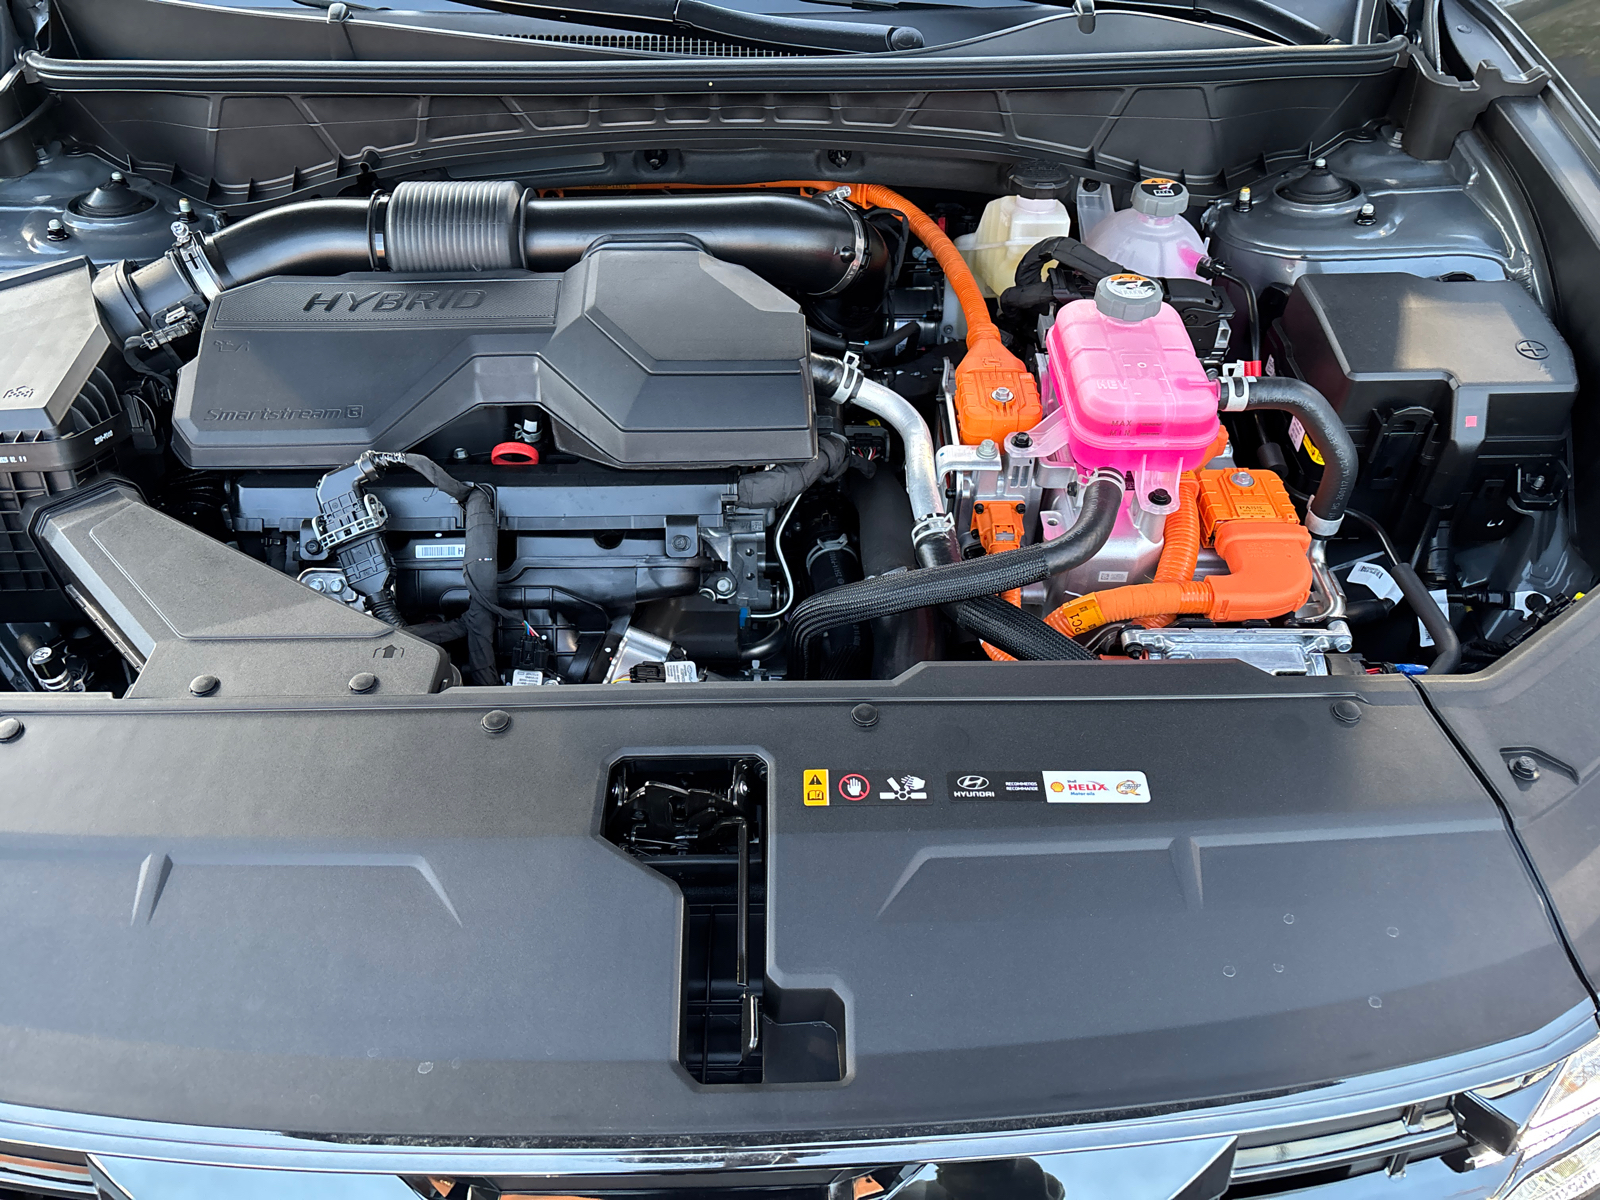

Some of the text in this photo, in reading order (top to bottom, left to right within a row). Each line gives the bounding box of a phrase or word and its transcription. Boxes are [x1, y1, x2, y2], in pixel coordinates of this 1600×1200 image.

[302, 288, 488, 313] HYBRID
[203, 404, 364, 422] Smartstream G
[1068, 783, 1108, 791] HELIX
